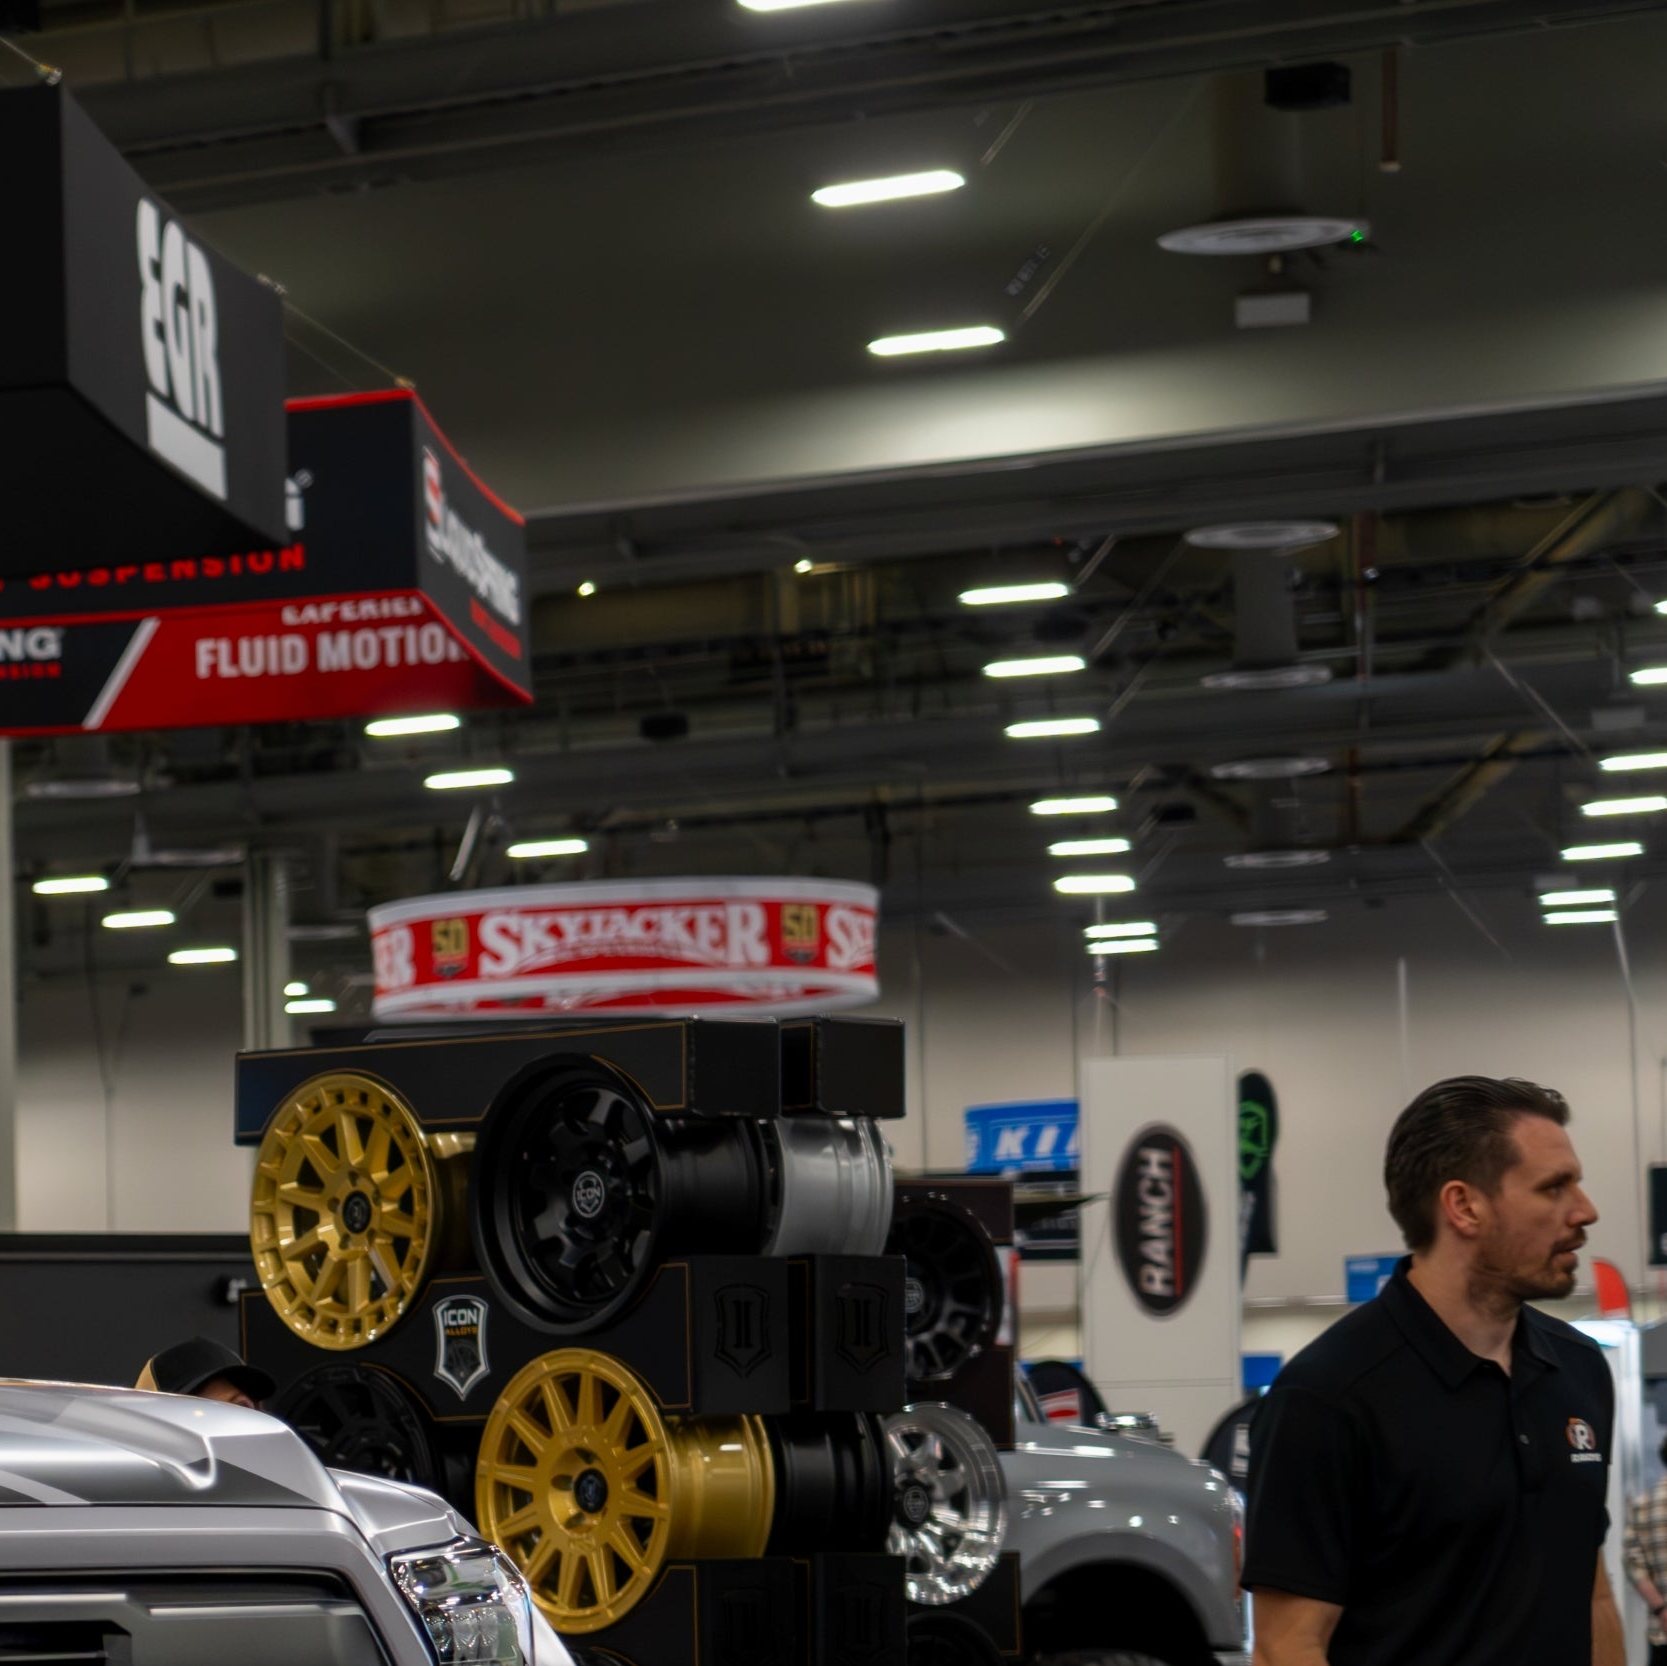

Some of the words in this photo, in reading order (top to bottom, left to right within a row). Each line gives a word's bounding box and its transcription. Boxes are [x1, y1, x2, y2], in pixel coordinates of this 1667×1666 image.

[135, 197, 226, 440] EGR
[195, 636, 311, 681] FLUID
[478, 902, 769, 978] SKYJACKER
[576, 1187, 601, 1201] ICON
[1138, 1147, 1174, 1298] RANCH
[443, 1308, 478, 1327] ICON
